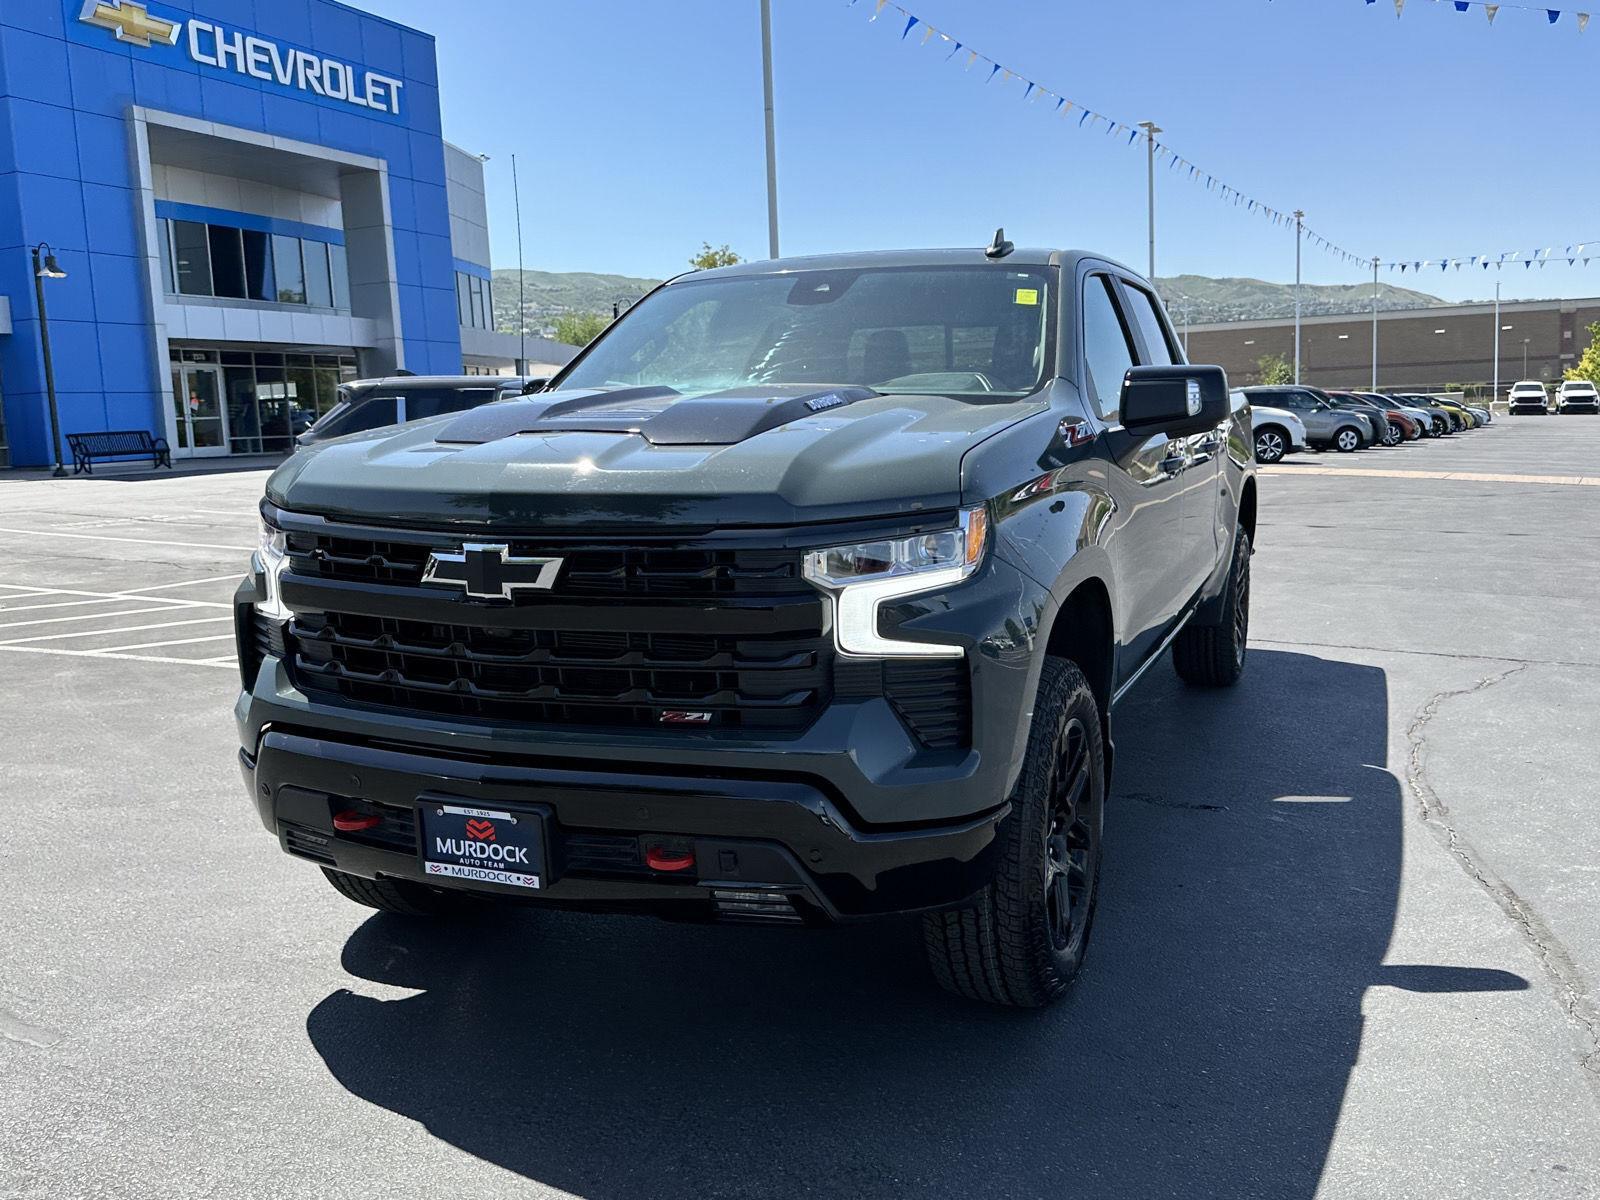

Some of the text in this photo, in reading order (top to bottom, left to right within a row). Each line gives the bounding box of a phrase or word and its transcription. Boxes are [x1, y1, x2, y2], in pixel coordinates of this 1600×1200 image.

[188, 19, 403, 114] CHEVROLET
[660, 711, 712, 722] Z71
[436, 837, 529, 864] MURDOCK
[459, 857, 505, 869] AUTO TEAM
[451, 866, 514, 884] MURDOCK
